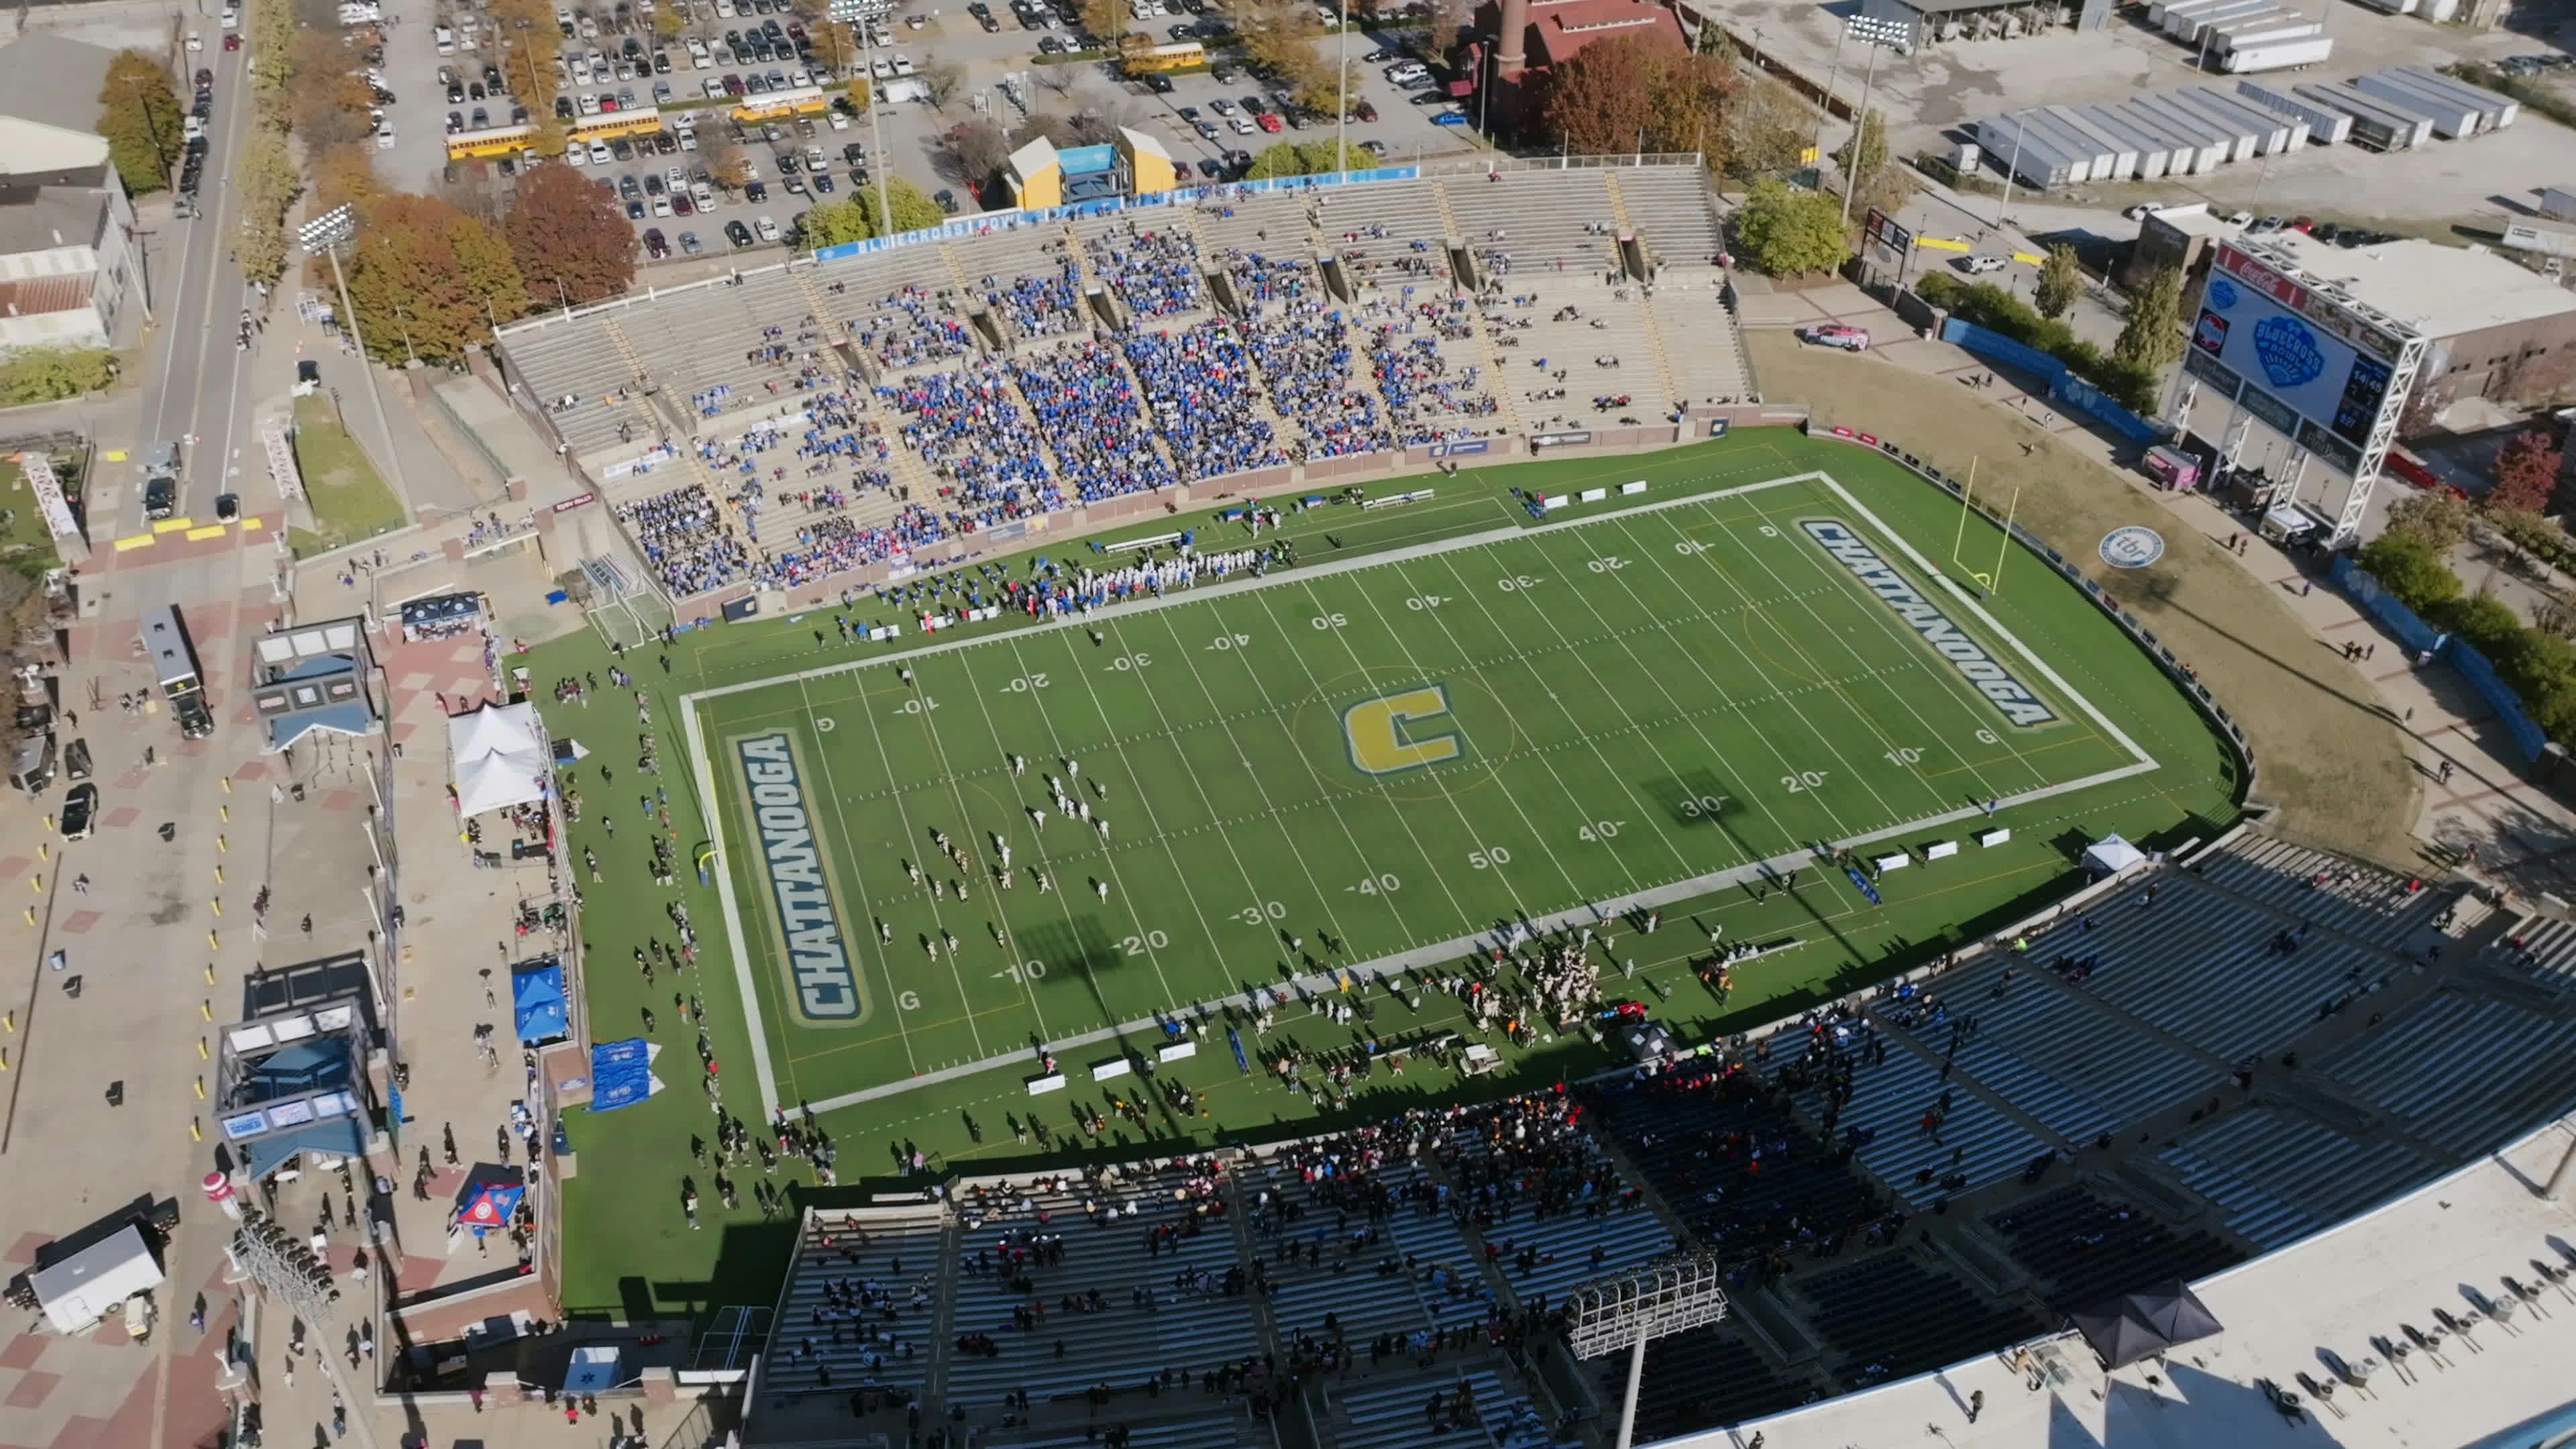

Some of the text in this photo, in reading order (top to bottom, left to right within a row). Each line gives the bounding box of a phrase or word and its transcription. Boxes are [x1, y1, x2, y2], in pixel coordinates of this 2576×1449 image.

[858, 223, 964, 254] BLUECROSS
[979, 210, 1026, 231] BOWL
[2257, 322, 2321, 372] BLUECROSS
[1588, 556, 1623, 573] 20
[1498, 575, 1534, 591] 30
[1406, 595, 1440, 611] 40
[1311, 612, 1347, 631] 50
[1806, 521, 2055, 727] CHATTANOOGA
[1214, 633, 1249, 650] 40
[1114, 653, 1151, 670] 30
[1010, 673, 1049, 692] 20
[904, 696, 940, 714] 10
[816, 717, 835, 732] G
[1344, 684, 1461, 774] C
[1975, 729, 1998, 745] G
[1884, 747, 1920, 766] 10
[1780, 771, 1823, 793] 20
[1680, 796, 1721, 817] 30
[1578, 820, 1618, 842] 40
[1468, 847, 1511, 869] 50
[741, 735, 857, 1016] CHATTANOOGA
[1360, 873, 1401, 896] 40
[1242, 901, 1286, 924] 30
[1123, 930, 1169, 956] 20
[1005, 960, 1046, 984] 10
[899, 991, 920, 1010] G
